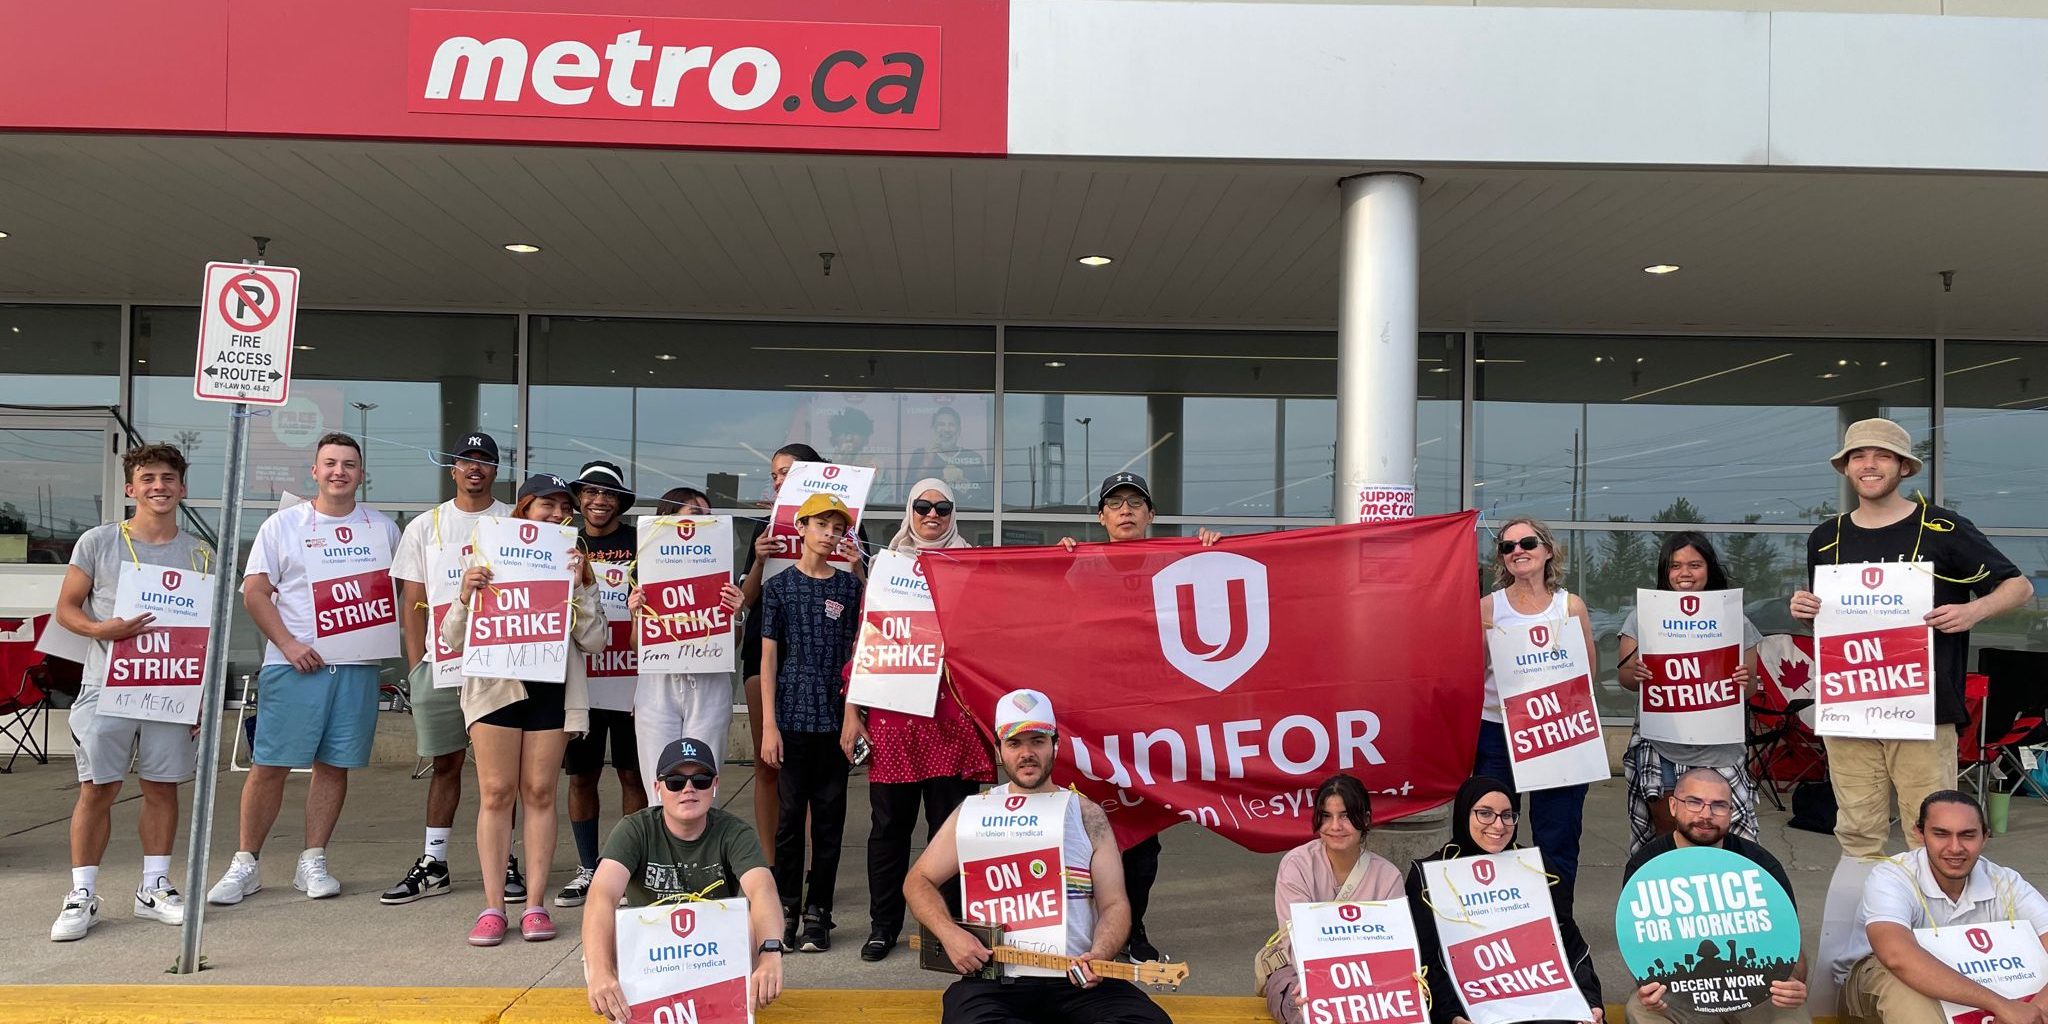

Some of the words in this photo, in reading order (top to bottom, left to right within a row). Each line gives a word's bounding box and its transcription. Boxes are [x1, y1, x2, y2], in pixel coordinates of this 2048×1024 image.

[424, 29, 924, 115] metro.ca
[231, 335, 262, 348] FIRE
[217, 351, 272, 366] ACCESS
[214, 382, 240, 390] BY-LAW
[220, 368, 266, 382] ROUTE
[803, 480, 848, 492] UNIFOR
[1360, 491, 1414, 503] SUPPORT
[1361, 502, 1414, 516] metro
[324, 547, 371, 557] UNIFOR
[500, 546, 552, 561] UNIFOR
[660, 545, 712, 555] UNIFOR
[332, 580, 362, 603] ON
[890, 576, 929, 590] UNIFO
[142, 592, 194, 608] UNIFOR
[496, 588, 530, 610] ON
[600, 590, 626, 602] NIFO
[662, 584, 695, 609] ON
[1841, 594, 1903, 606] UNIFOR
[318, 598, 392, 631] STRIKE
[645, 606, 727, 638] STRIKE
[1663, 620, 1717, 630] UNIFOR
[475, 612, 561, 640] STRIKE
[882, 617, 911, 639] ON
[136, 632, 170, 654] ON
[1843, 638, 1884, 664] ON
[582, 650, 637, 671] TRIKE
[863, 644, 936, 667] STRIKE
[1516, 649, 1568, 666] UNIFOR
[113, 658, 200, 680] STRIKE
[1665, 657, 1701, 680] ON
[1823, 663, 1924, 696] STRIKE
[1648, 678, 1736, 707] STRIKE
[1526, 691, 1562, 720] ON
[1865, 706, 1915, 725] Metro
[1514, 710, 1595, 754] STRIKE
[1070, 709, 1386, 787] UNIFOR
[982, 815, 1038, 827] UNIFOR
[985, 862, 1022, 892] ON
[1459, 887, 1521, 907] UNIFOR
[1630, 869, 1767, 918] JUSTICE
[969, 889, 1058, 926] STRIKE
[1321, 924, 1386, 935] UNIFOR
[1634, 918, 1673, 943] FOR
[1676, 908, 1772, 939] WORKERS
[649, 942, 718, 961] UNIFOR
[1473, 938, 1516, 972] ON
[1330, 960, 1373, 989] ON
[1957, 956, 2025, 975] UNIFOR
[1463, 960, 1564, 998] STRIKE
[1671, 977, 1722, 993] DECENT
[1724, 974, 1766, 988] WORK
[1311, 989, 1417, 1024] STRIKE
[1693, 991, 1719, 1005] FOR
[1722, 988, 1748, 1002] ALL
[653, 999, 698, 1024] ON
